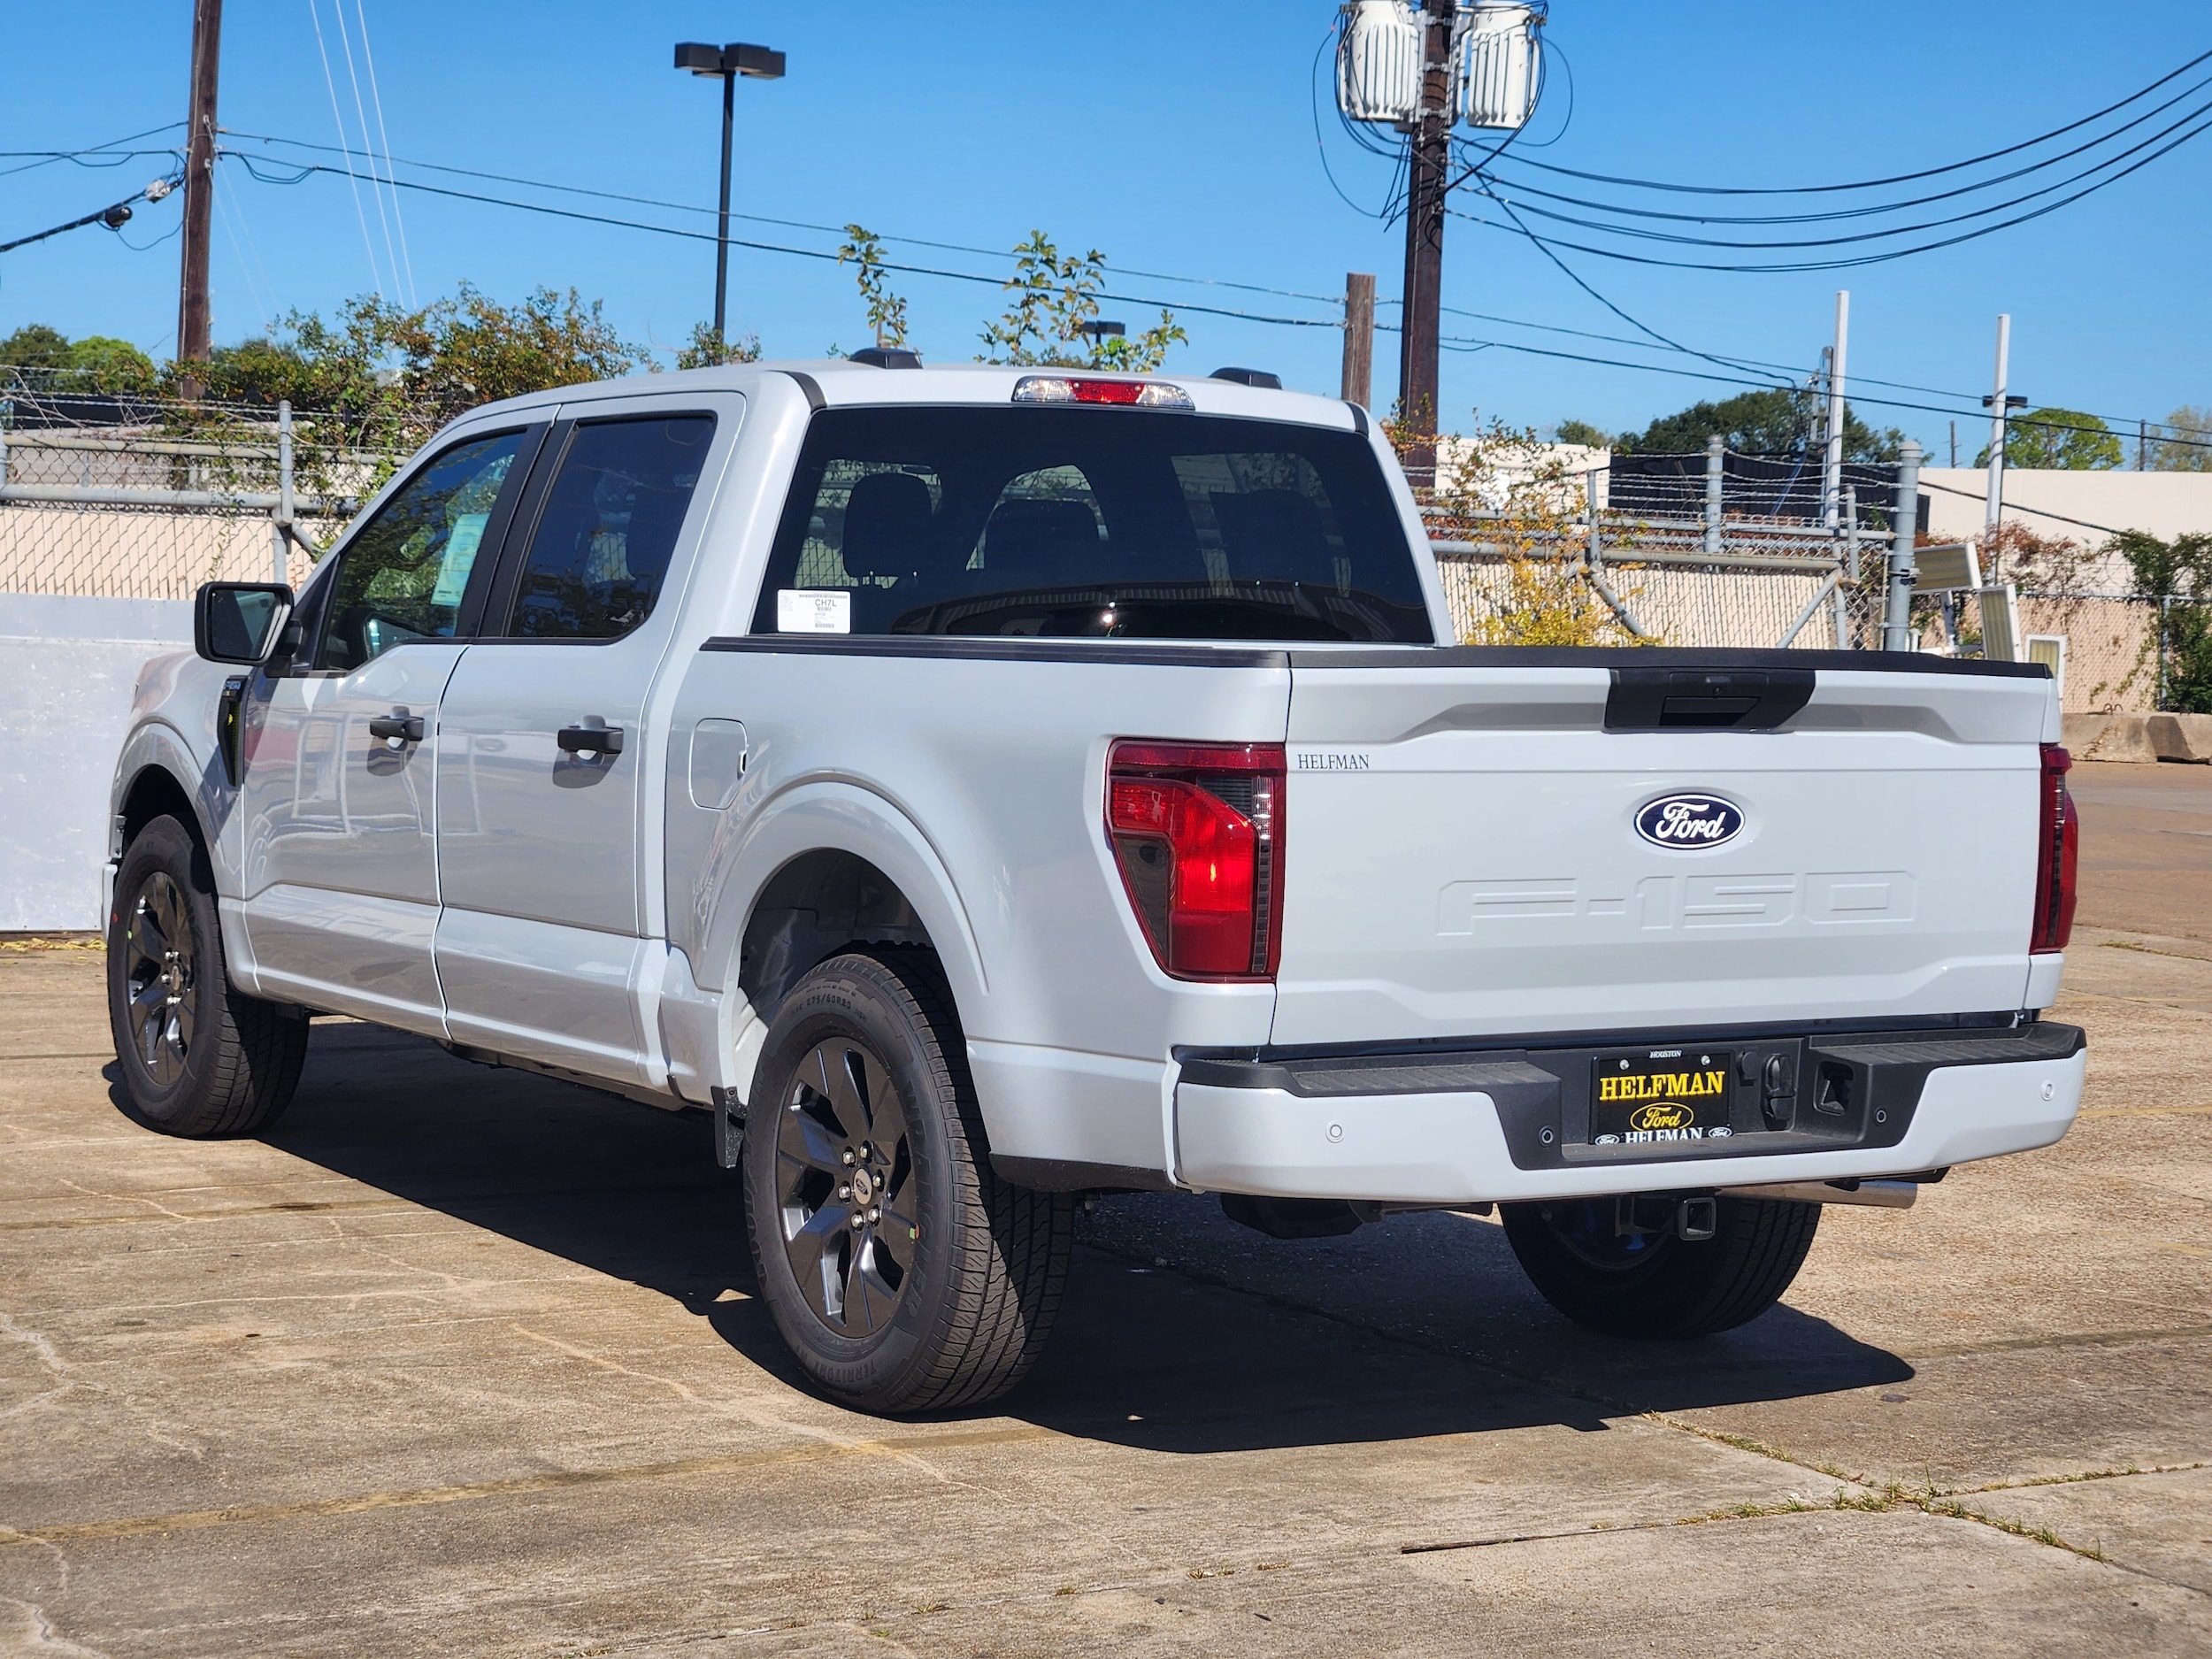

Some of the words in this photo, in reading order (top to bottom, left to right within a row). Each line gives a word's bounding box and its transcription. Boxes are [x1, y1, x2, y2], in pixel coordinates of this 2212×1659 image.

[1297, 754, 1370, 770] HELFMAN
[1655, 802, 1726, 839] Ford
[1435, 870, 1917, 936] F-150
[1649, 1049, 1682, 1058] HOUSTON
[1599, 1071, 1725, 1101] HELFMAN
[1642, 1106, 1682, 1129] Ford
[1624, 1127, 1703, 1144] HELFMAN
